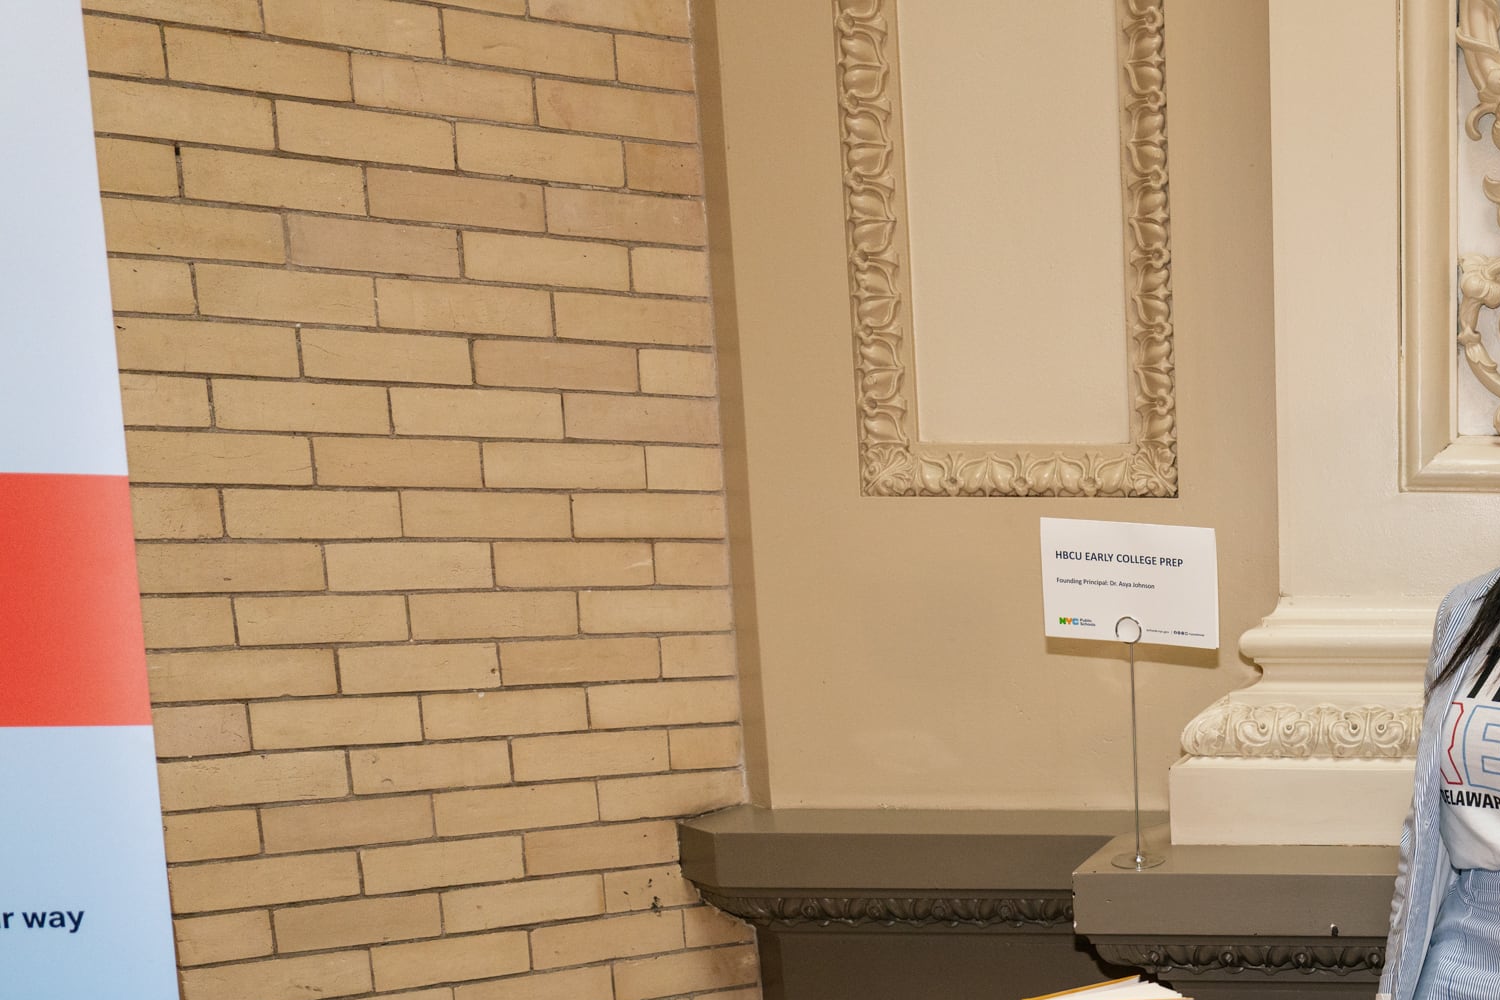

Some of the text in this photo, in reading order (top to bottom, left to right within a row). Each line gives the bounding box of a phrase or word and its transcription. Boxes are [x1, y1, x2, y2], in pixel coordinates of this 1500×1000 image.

[1055, 550, 1184, 567] HBCU EARLY COLLEGE PREP
[1056, 577, 1082, 585] Founding
[1083, 578, 1108, 587] Principal:
[1059, 617, 1079, 625] NYC
[22, 909, 85, 934] way
